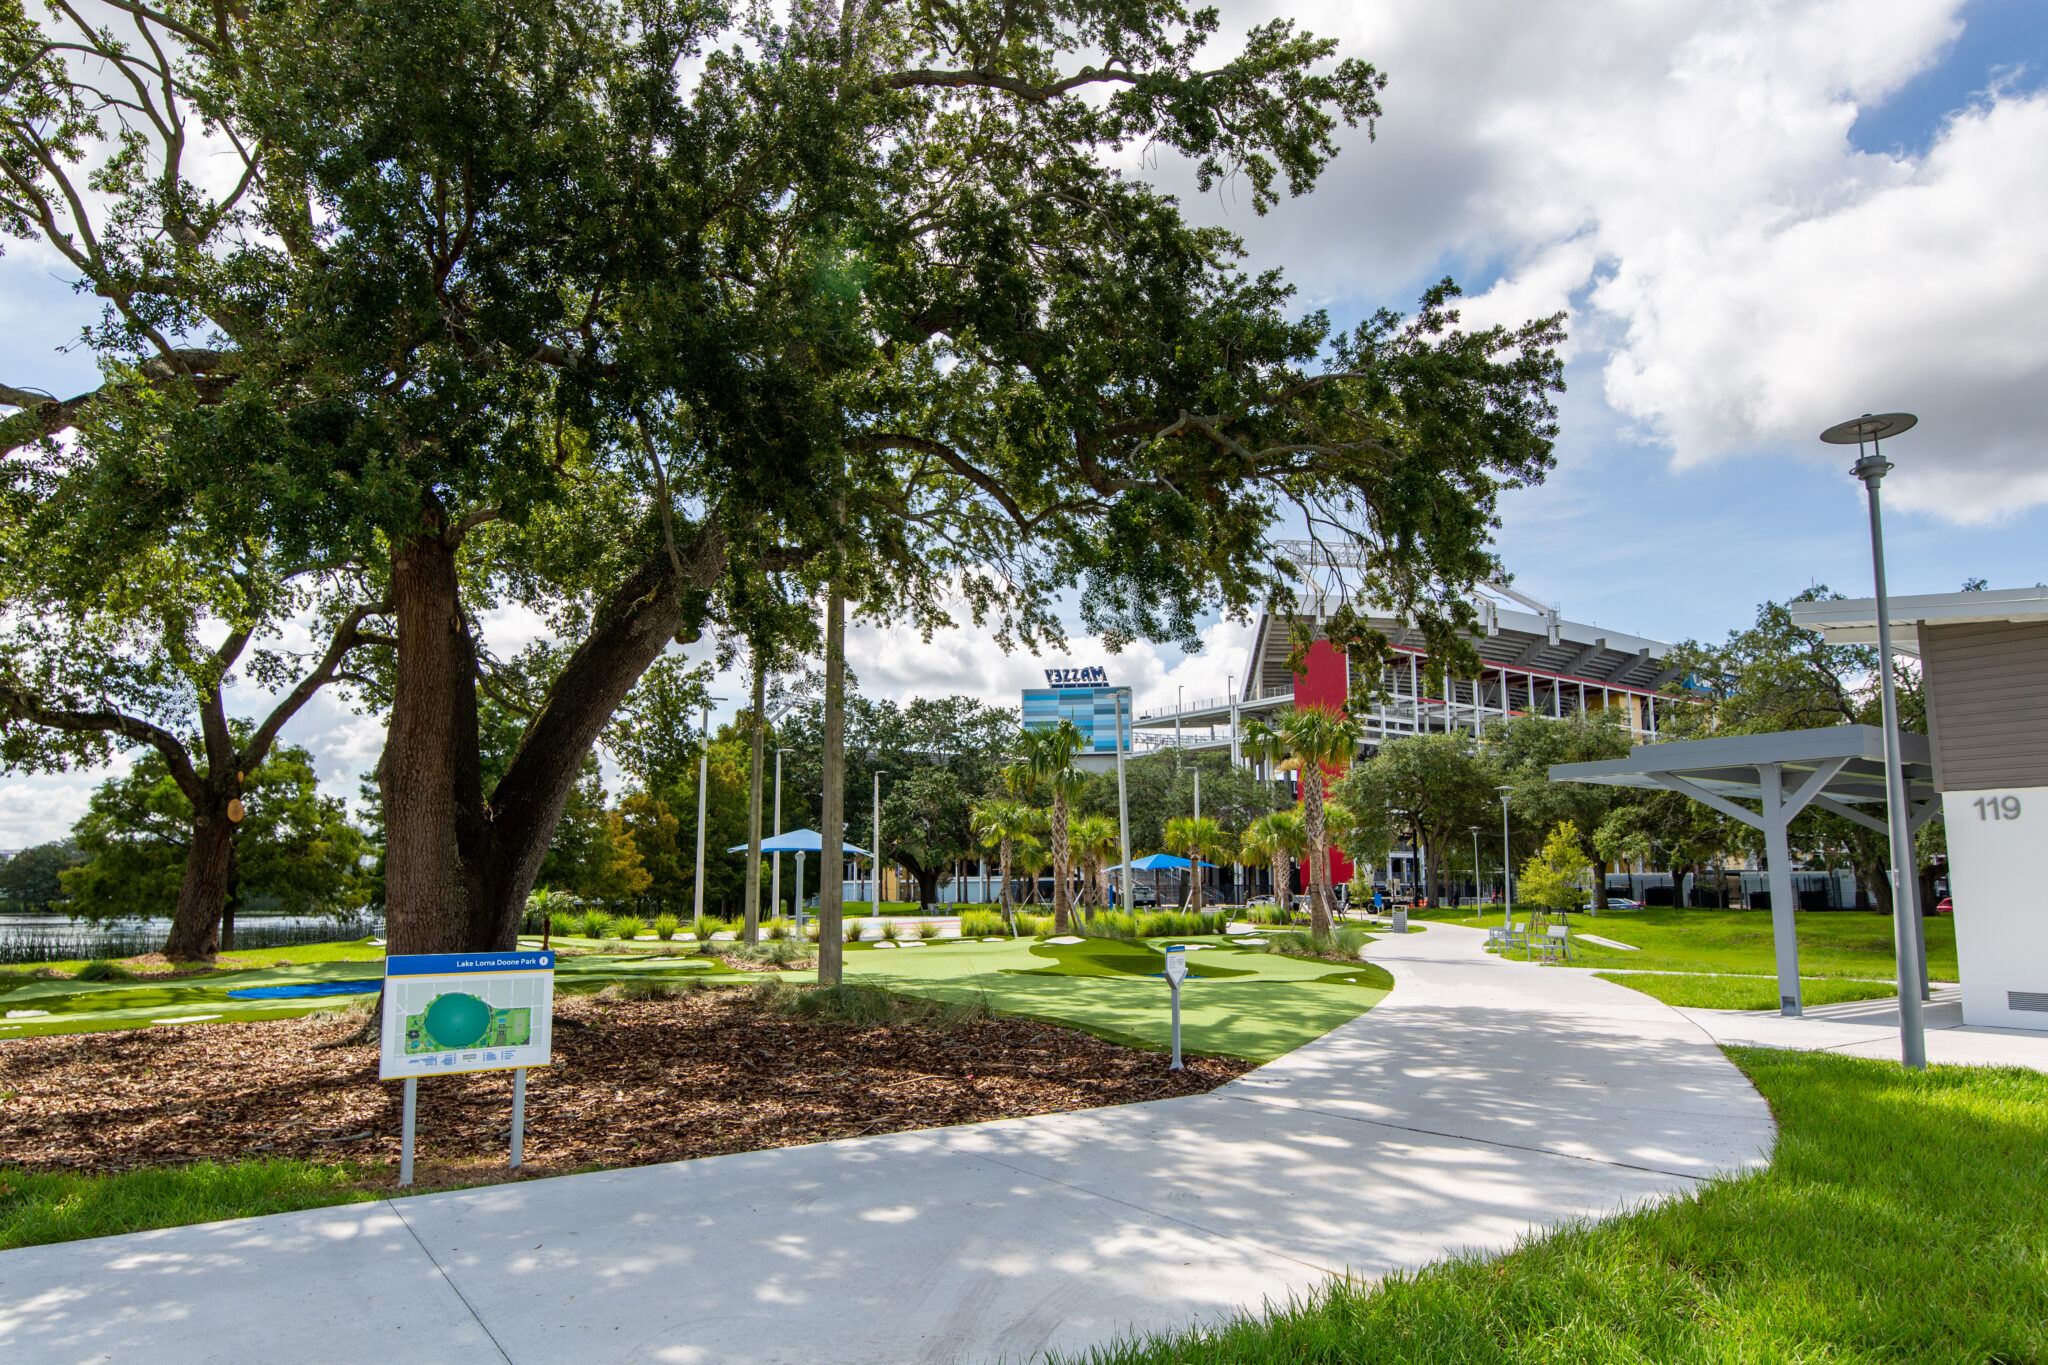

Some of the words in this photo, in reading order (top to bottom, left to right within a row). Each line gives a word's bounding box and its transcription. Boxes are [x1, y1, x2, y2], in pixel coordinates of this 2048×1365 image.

[1973, 795, 2021, 821] 119
[475, 959, 496, 967] Lorna
[521, 957, 537, 965] Park
